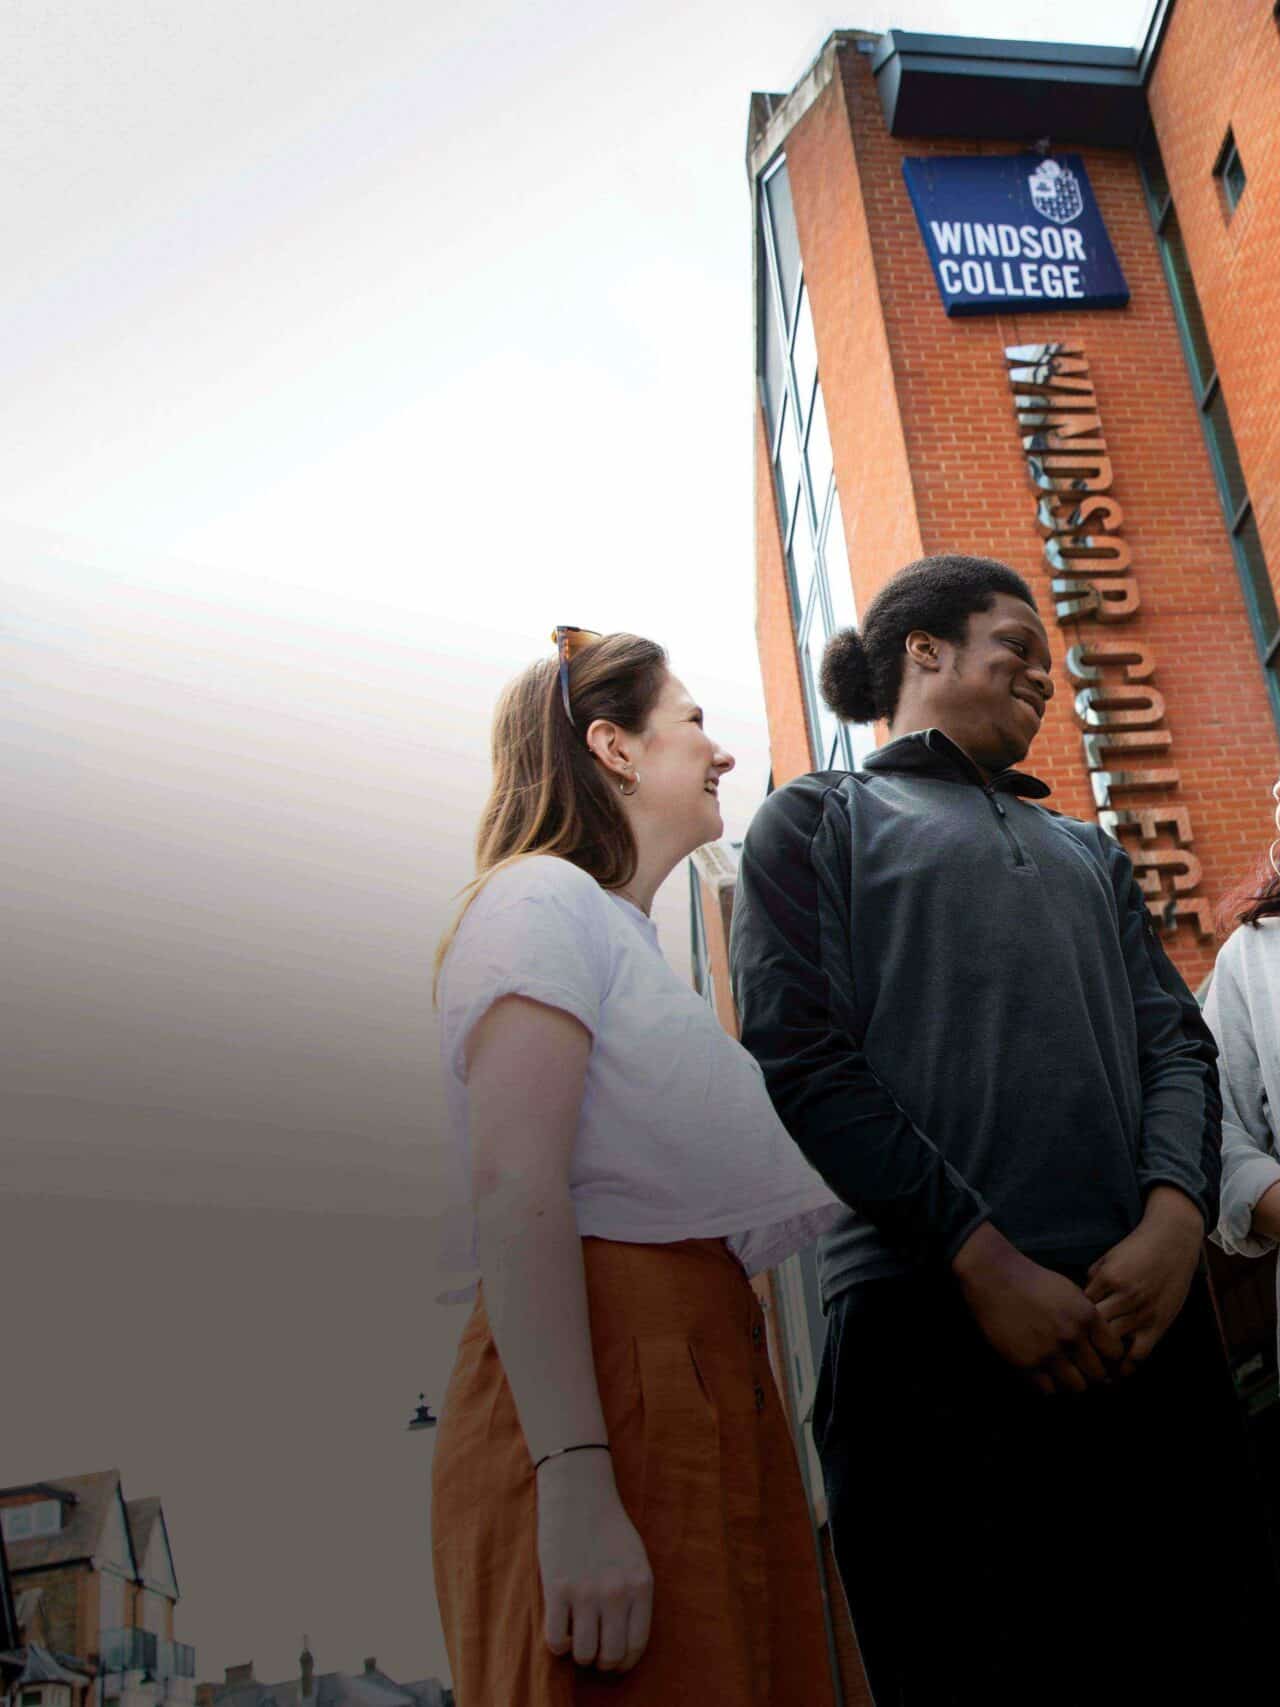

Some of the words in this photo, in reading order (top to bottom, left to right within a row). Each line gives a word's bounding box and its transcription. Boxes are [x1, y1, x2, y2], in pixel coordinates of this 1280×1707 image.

[930, 220, 1087, 261] WINDSOR
[938, 259, 1085, 298] COLLEGE
[1003, 341, 1141, 620] WINDSOR
